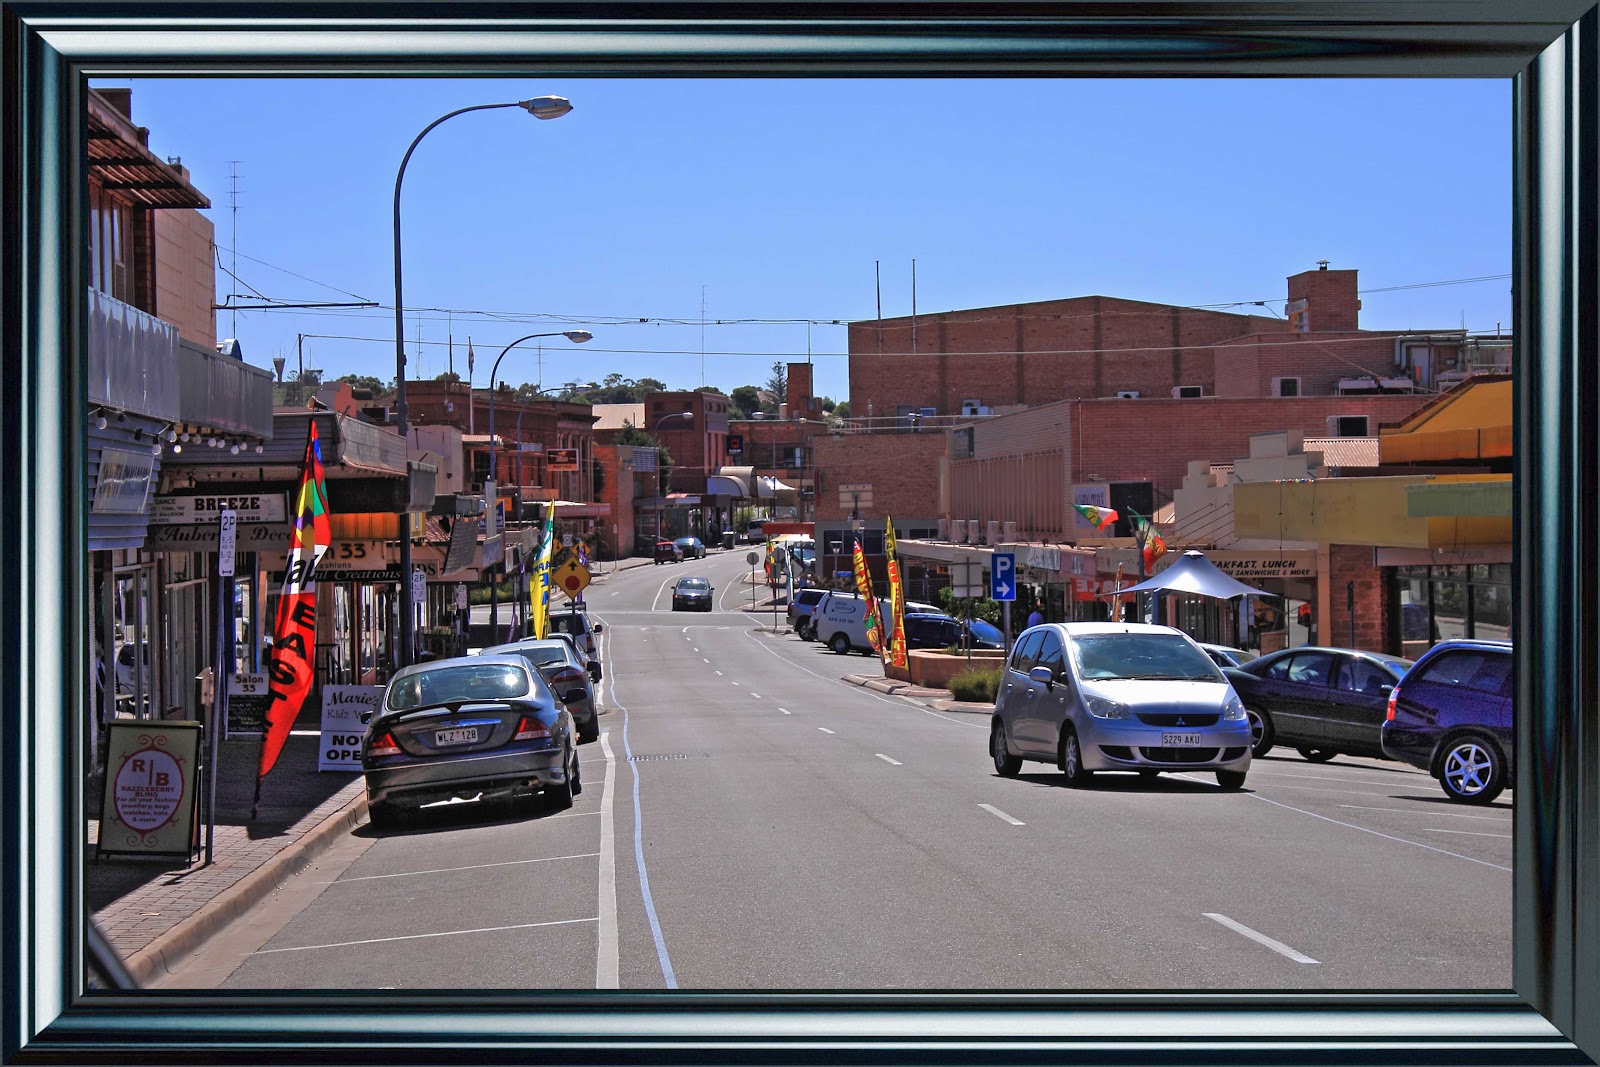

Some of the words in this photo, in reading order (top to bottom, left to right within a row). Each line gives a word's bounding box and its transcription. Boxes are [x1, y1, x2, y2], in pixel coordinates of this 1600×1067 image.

[194, 497, 260, 511] BREEZE
[222, 516, 236, 531] 2P
[341, 544, 366, 559] 33
[996, 556, 1011, 579] P
[334, 570, 401, 581] Creations
[235, 675, 264, 684] Salon
[242, 684, 256, 692] 33
[332, 735, 364, 746] NO
[437, 732, 455, 742] WLZ
[1163, 735, 1182, 744] S229
[1184, 735, 1200, 744] AKU
[326, 750, 362, 760] OPE
